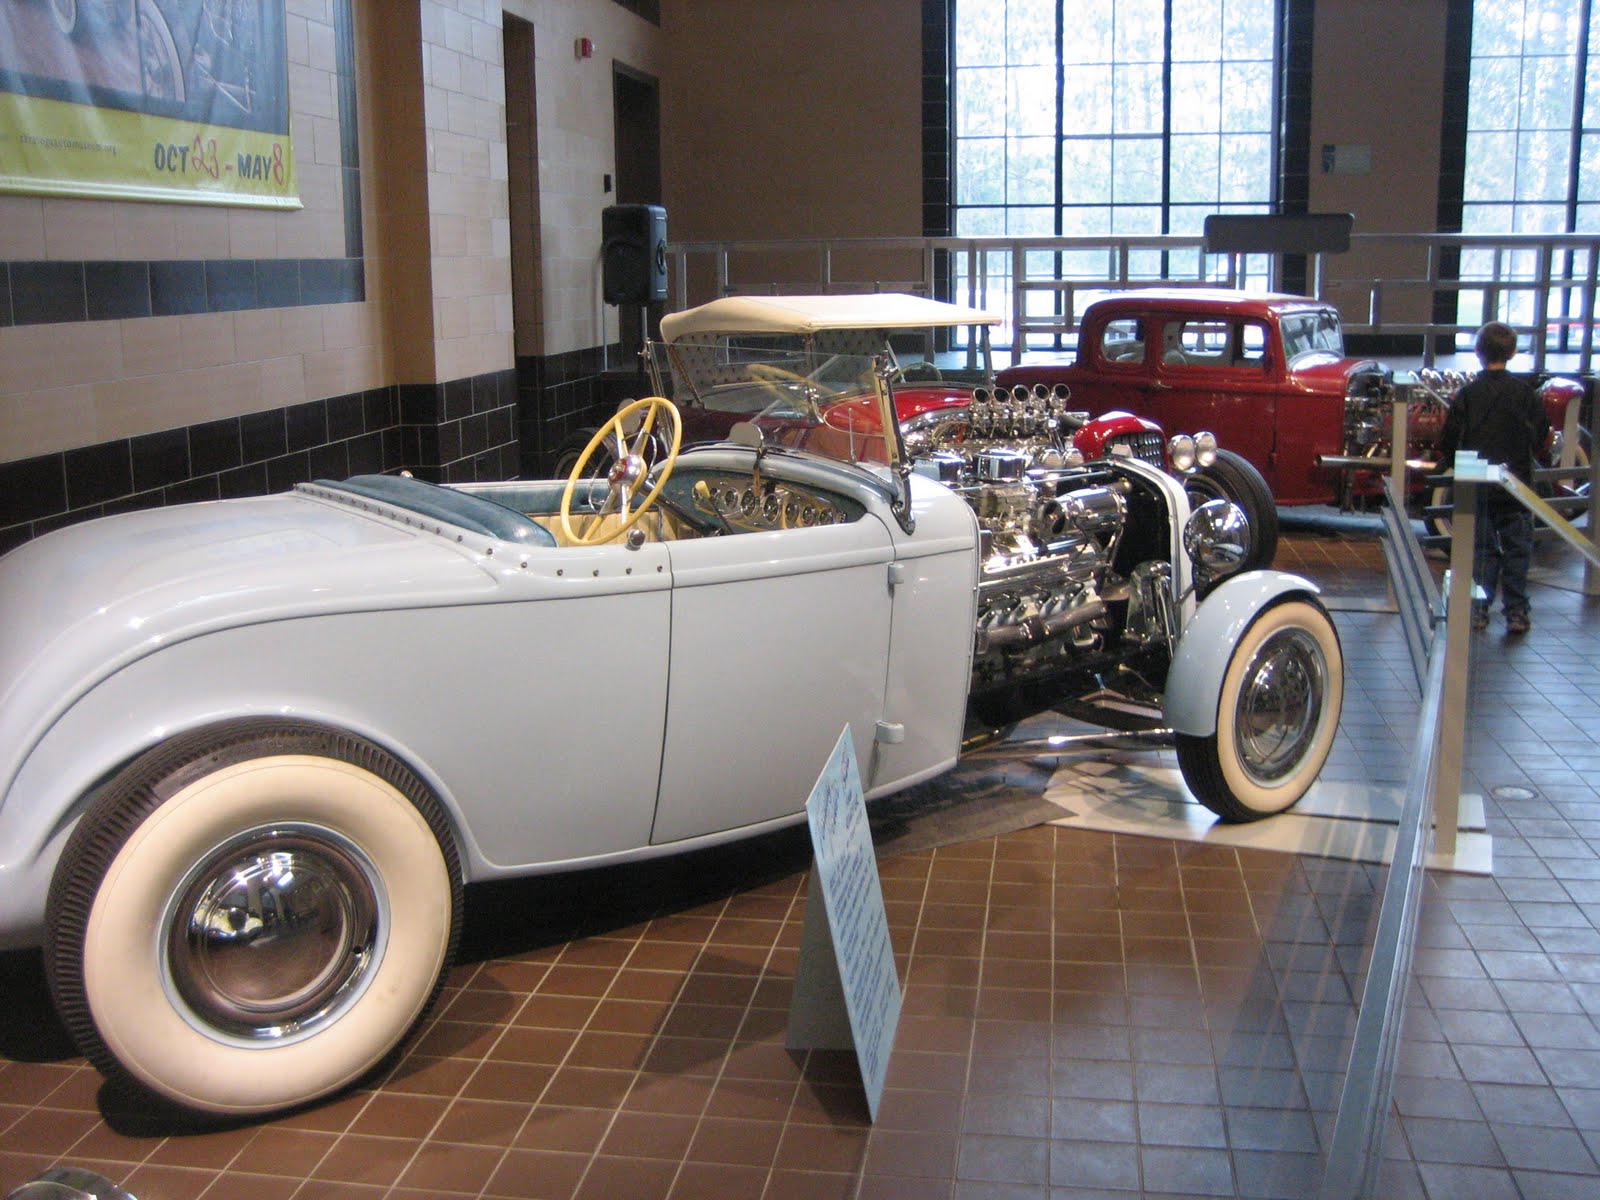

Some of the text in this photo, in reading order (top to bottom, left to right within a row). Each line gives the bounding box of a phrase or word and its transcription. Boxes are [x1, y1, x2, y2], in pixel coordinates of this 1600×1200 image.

[154, 143, 190, 173] OCT
[191, 133, 220, 179] 23
[238, 152, 273, 181] MAY
[272, 142, 285, 186] 8
